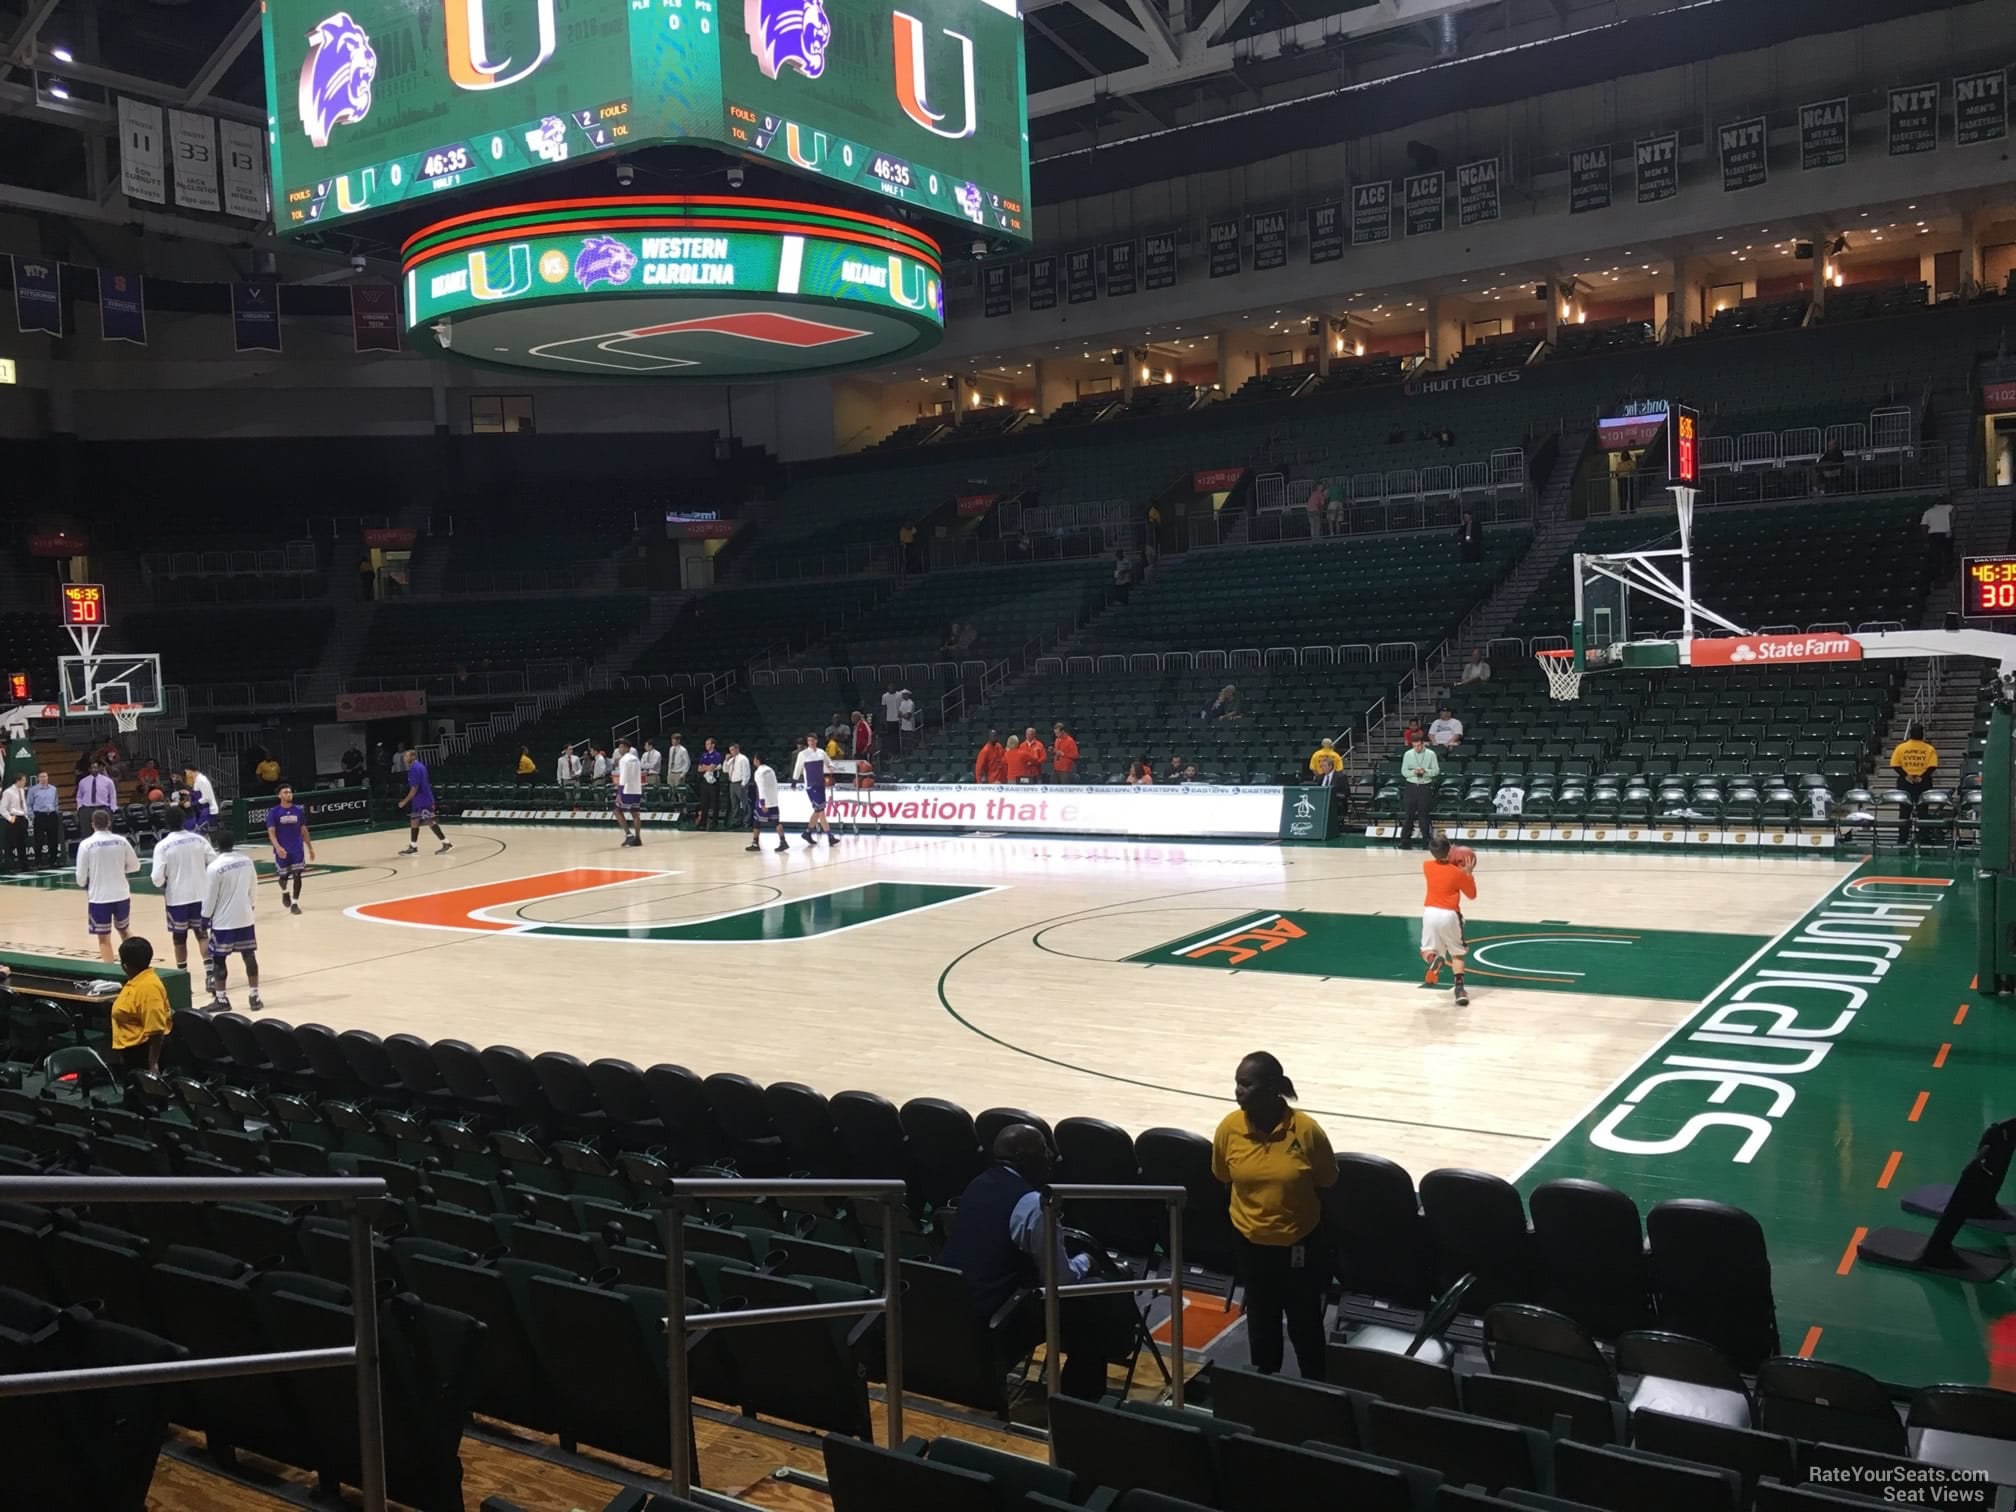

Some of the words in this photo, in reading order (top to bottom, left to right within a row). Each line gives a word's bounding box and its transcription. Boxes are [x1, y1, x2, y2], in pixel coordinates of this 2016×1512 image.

[669, 14, 680, 30] 0
[700, 17, 710, 34] 0
[1957, 75, 2002, 101] NIT
[1892, 90, 1936, 113] NIT
[1966, 104, 1996, 115] MEN'S
[582, 111, 591, 126] 2
[600, 103, 628, 119] FOULS
[730, 106, 757, 123] FOULS
[764, 117, 772, 131] 0
[1803, 105, 1844, 129] NCAA
[1899, 117, 1928, 128] MEN'S
[133, 132, 150, 152] 11
[596, 130, 604, 144] 4
[612, 125, 628, 137] TOL
[732, 127, 747, 141] TOL
[755, 135, 763, 148] 4
[1723, 125, 1762, 150] NIT
[1810, 128, 1837, 138] MEN'S
[179, 141, 209, 162] 33
[231, 152, 253, 170] 13
[786, 122, 827, 171] U
[842, 145, 853, 167] 0
[874, 157, 910, 186] 46:35
[929, 174, 938, 195] 0
[1572, 150, 1606, 172] NCAA
[1638, 141, 1674, 164] NIT
[1731, 151, 1757, 162] MEN'S
[335, 168, 376, 214] U
[390, 164, 402, 186] 0
[424, 148, 467, 177] 46:35
[491, 136, 503, 159] 0
[433, 178, 453, 190] HALF
[455, 174, 460, 184] 1
[1461, 163, 1495, 187] NCAA
[1644, 168, 1669, 177] MEN'S
[289, 190, 310, 203] FOULS
[317, 184, 325, 196] 0
[881, 181, 898, 195] HALF
[900, 189, 905, 198] 1
[1359, 187, 1385, 206] ACC
[1411, 177, 1438, 197] ACC
[291, 210, 304, 220] TOL
[310, 205, 317, 217] 4
[992, 195, 999, 207] 2
[1003, 200, 1021, 213] FOULS
[1001, 215, 1007, 227] 4
[1255, 215, 1285, 234] NCAA
[1316, 208, 1335, 227] NIT
[1210, 223, 1238, 242] NCAA
[642, 237, 728, 260] WESTERN
[468, 243, 532, 300] U
[642, 263, 734, 285] CAROLINA
[841, 260, 888, 288] MIAMI
[887, 256, 926, 310] U
[1607, 431, 1624, 440] 101
[66, 588, 99, 600] 46:35
[1983, 585, 2014, 608] 30
[72, 601, 96, 621] 30
[987, 797, 1048, 821] that
[1185, 918, 1307, 965] ACC
